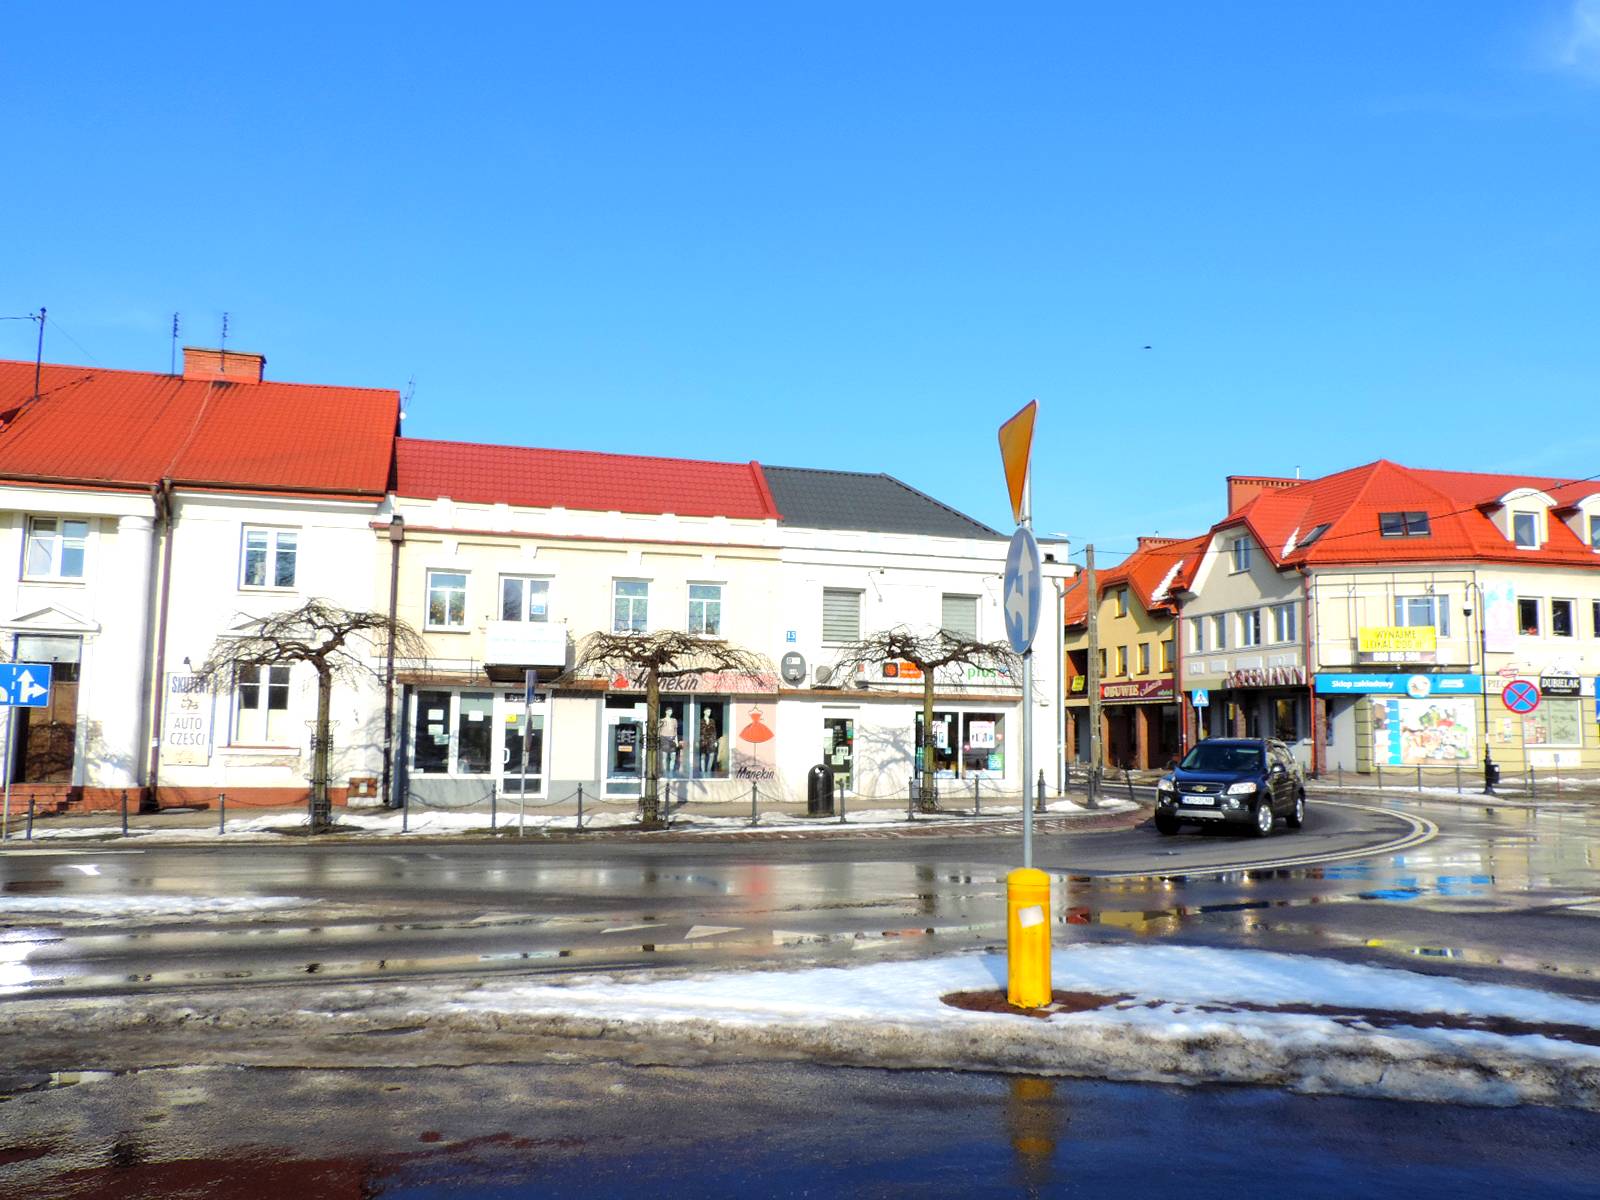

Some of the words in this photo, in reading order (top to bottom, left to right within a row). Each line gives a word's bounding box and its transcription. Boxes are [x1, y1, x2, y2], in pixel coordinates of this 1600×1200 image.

[787, 631, 796, 639] 15
[632, 668, 698, 691] Mnekin
[174, 717, 202, 730] AUTO
[736, 767, 775, 779] Manekin
